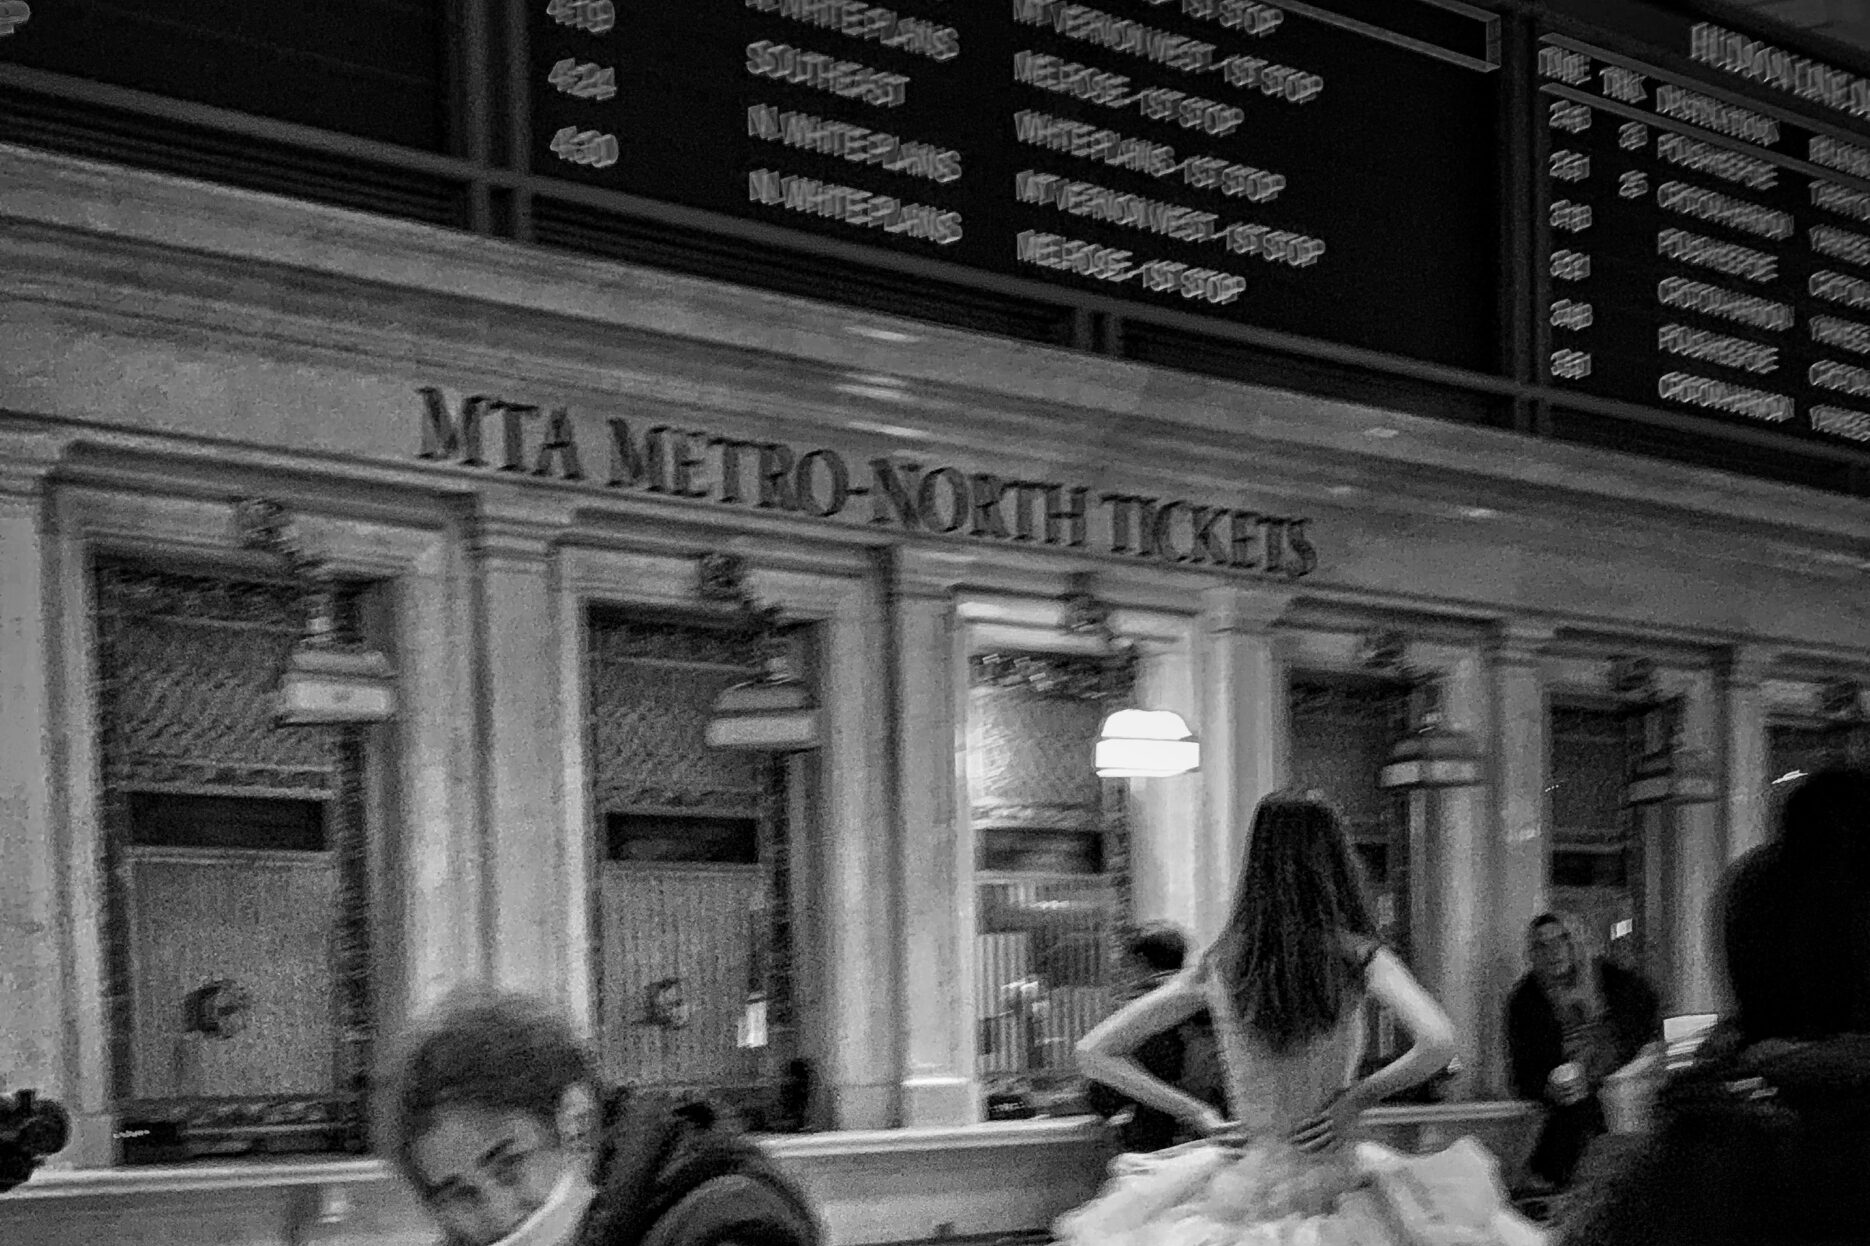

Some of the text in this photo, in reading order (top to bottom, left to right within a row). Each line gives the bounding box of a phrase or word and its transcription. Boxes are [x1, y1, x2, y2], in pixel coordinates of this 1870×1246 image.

[415, 386, 1319, 577] MTA METRO-NORTH TICKETS
